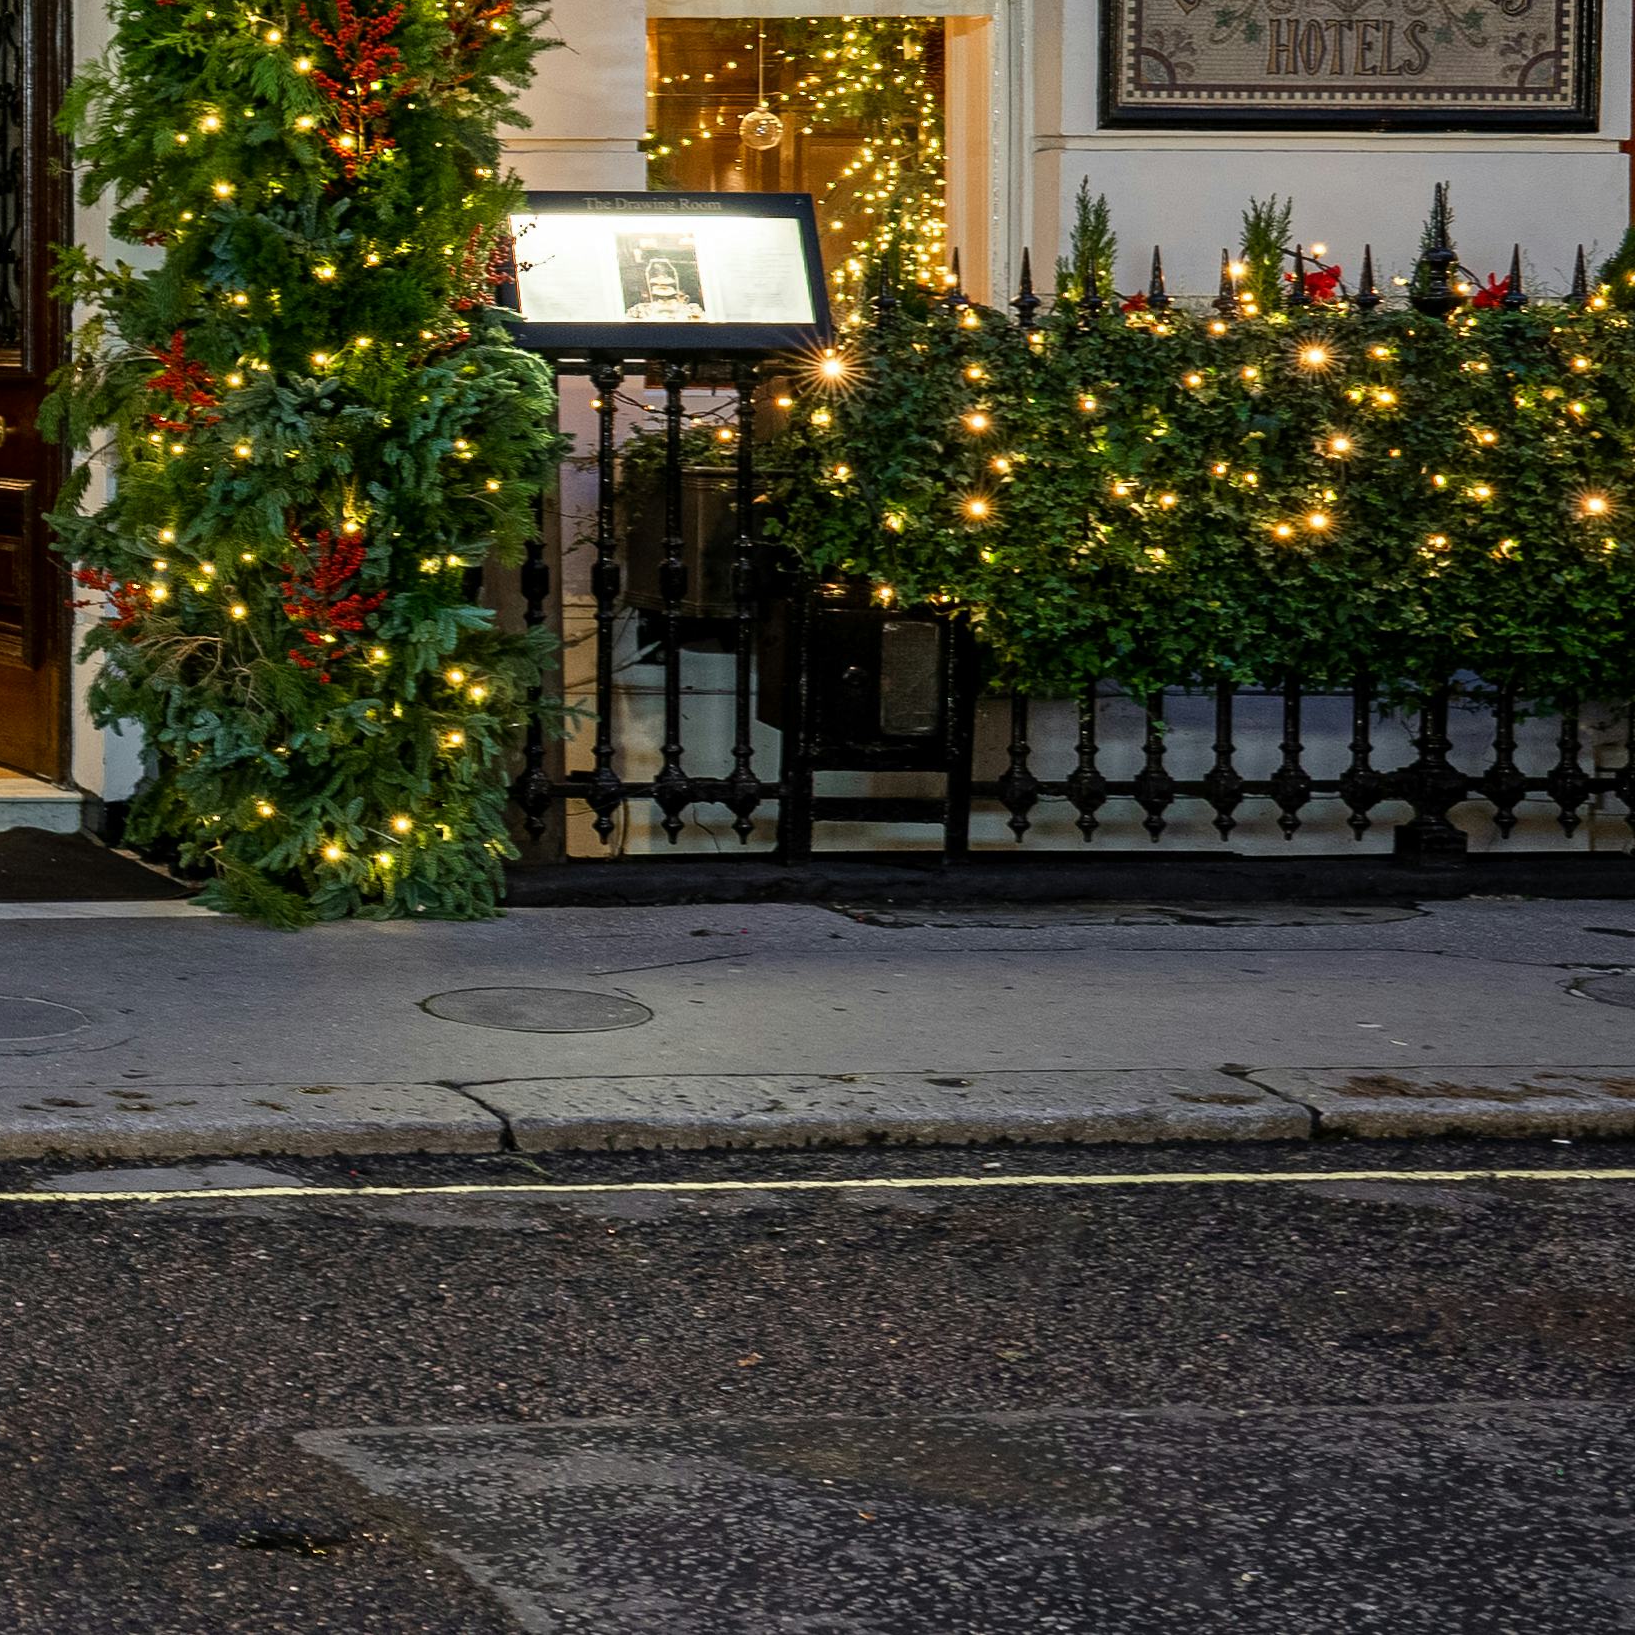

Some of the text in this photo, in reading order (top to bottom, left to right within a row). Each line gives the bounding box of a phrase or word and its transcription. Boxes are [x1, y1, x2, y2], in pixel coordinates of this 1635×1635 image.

[1265, 18, 1432, 76] HOTELS
[583, 196, 723, 214] The Drawing Room
